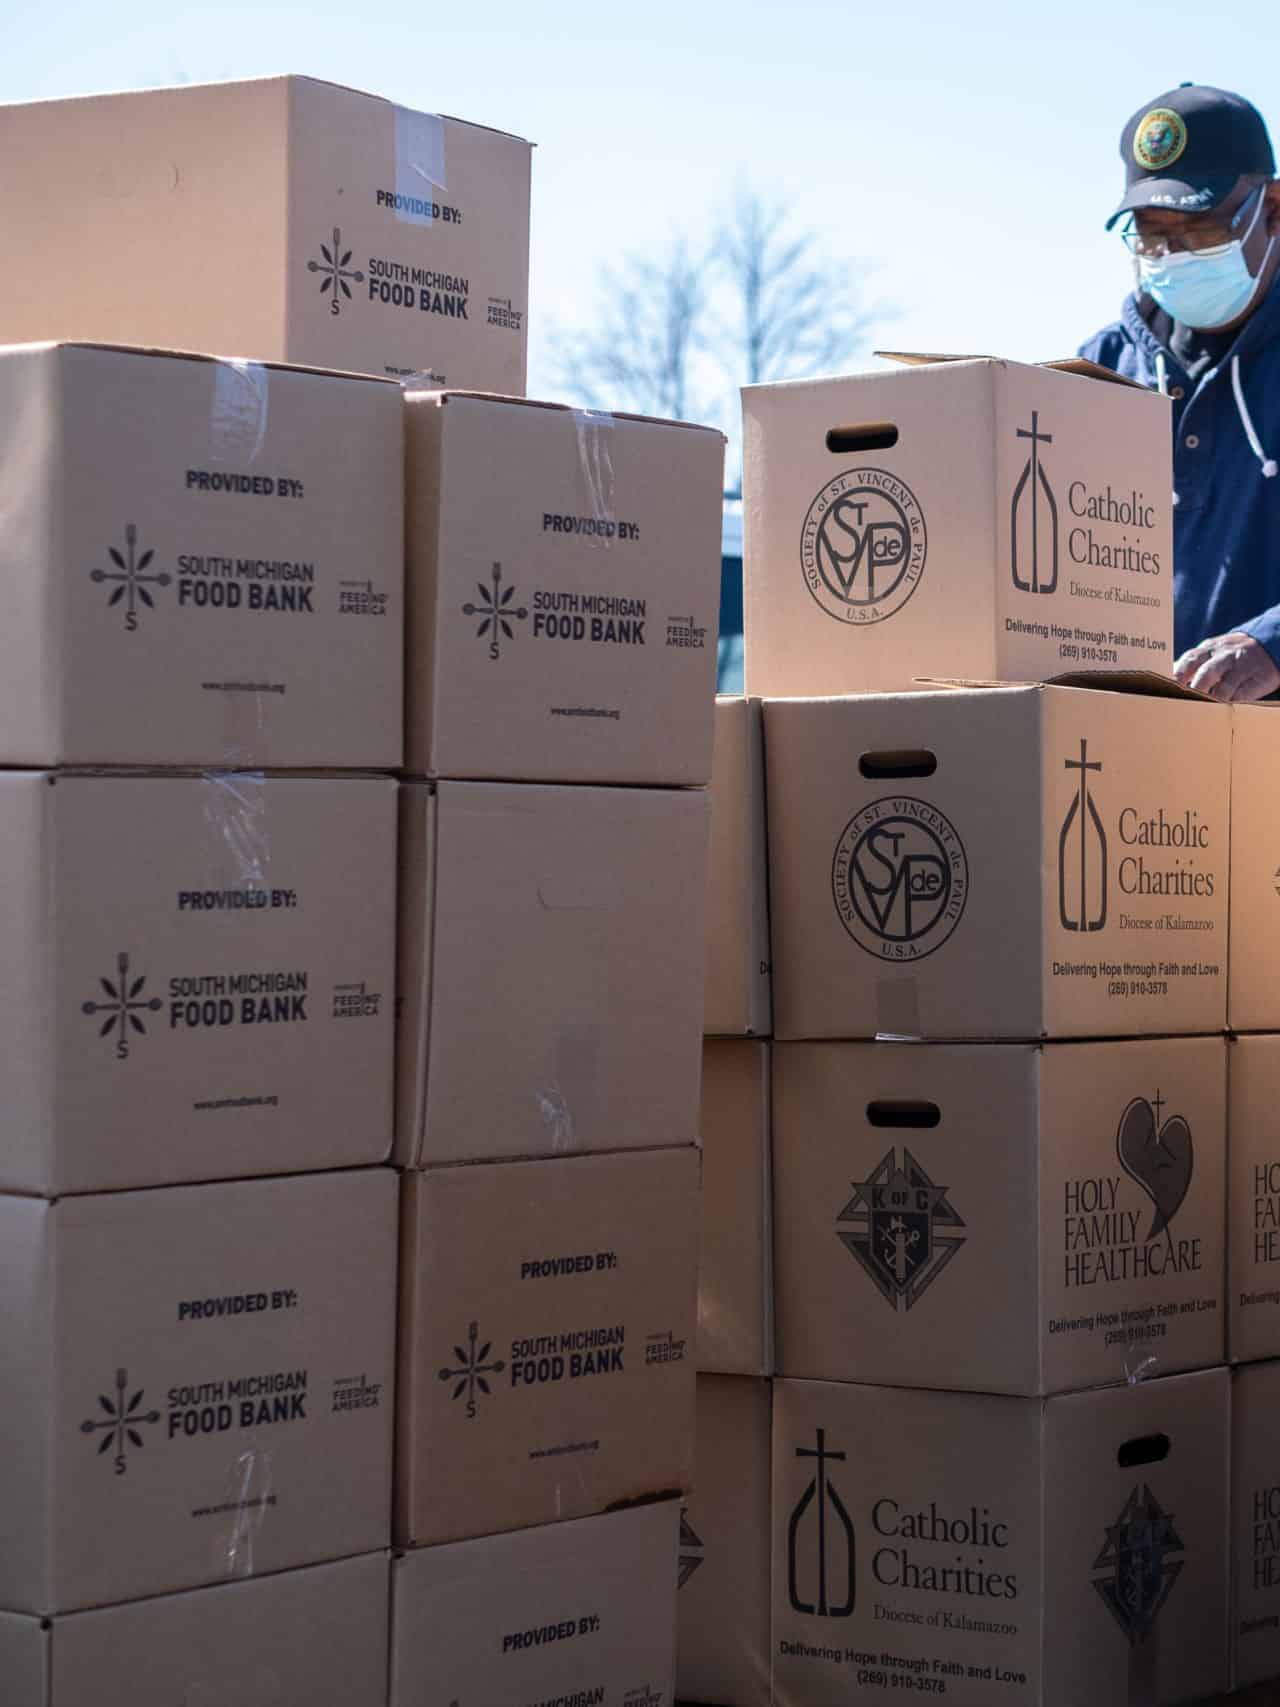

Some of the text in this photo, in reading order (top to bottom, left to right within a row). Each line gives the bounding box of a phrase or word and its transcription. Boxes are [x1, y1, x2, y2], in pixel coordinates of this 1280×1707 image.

[376, 190, 461, 224] PROVIDED BY:
[369, 259, 469, 295] SOUTH MICHIGAN
[369, 279, 469, 320] FOOD BANK
[487, 318, 520, 329] AMERICA
[186, 470, 304, 498] PROVIDED BY:
[1068, 481, 1155, 529] Catholic
[543, 513, 639, 540] PROVIDED BY:
[803, 472, 924, 591] SOCIETY of ST. VINCENT de PAUL
[178, 555, 314, 581] SOUTH MICHIGAN
[1069, 528, 1161, 576] Charities
[178, 580, 313, 613] FOOD BANK
[534, 591, 646, 617] SOUTH MICHIGAN
[1070, 581, 1161, 608] Diocese of Kalamazoo
[534, 613, 645, 645] FOOD BANK
[847, 606, 884, 619] U.S.A.
[1006, 618, 1166, 651] Delivering Hope through Faith and Love
[1059, 643, 1079, 660] (269)
[1118, 807, 1209, 848] Catholic
[1118, 857, 1214, 897] Charities
[178, 889, 296, 910] PROVIDED BY:
[169, 972, 307, 998] SOUTH MICHIGAN
[170, 995, 307, 1028] FOOD BANK
[1064, 1177, 1121, 1215] HOLY
[1064, 1210, 1142, 1251] FAMILY
[521, 1252, 617, 1279] PROVIDED BY:
[1064, 1239, 1201, 1287] HEALTHCARE
[178, 1289, 296, 1320] PROVIDED BY:
[512, 1326, 624, 1358] SOUTH MICHIGAN
[512, 1347, 624, 1386] FOOD BANK
[168, 1370, 307, 1408] SOUTH MICHIGAN
[168, 1393, 306, 1439] FOOD BANK
[872, 1497, 1008, 1548] Catholic
[872, 1548, 1017, 1600] Charities
[503, 1615, 600, 1653] PROVIDED BY:
[873, 1603, 1018, 1637] Diocese of Kalamazoo
[780, 1640, 1027, 1684] Delivering Hope through Faith and Love
[857, 1668, 946, 1694] (269) 910-3578
